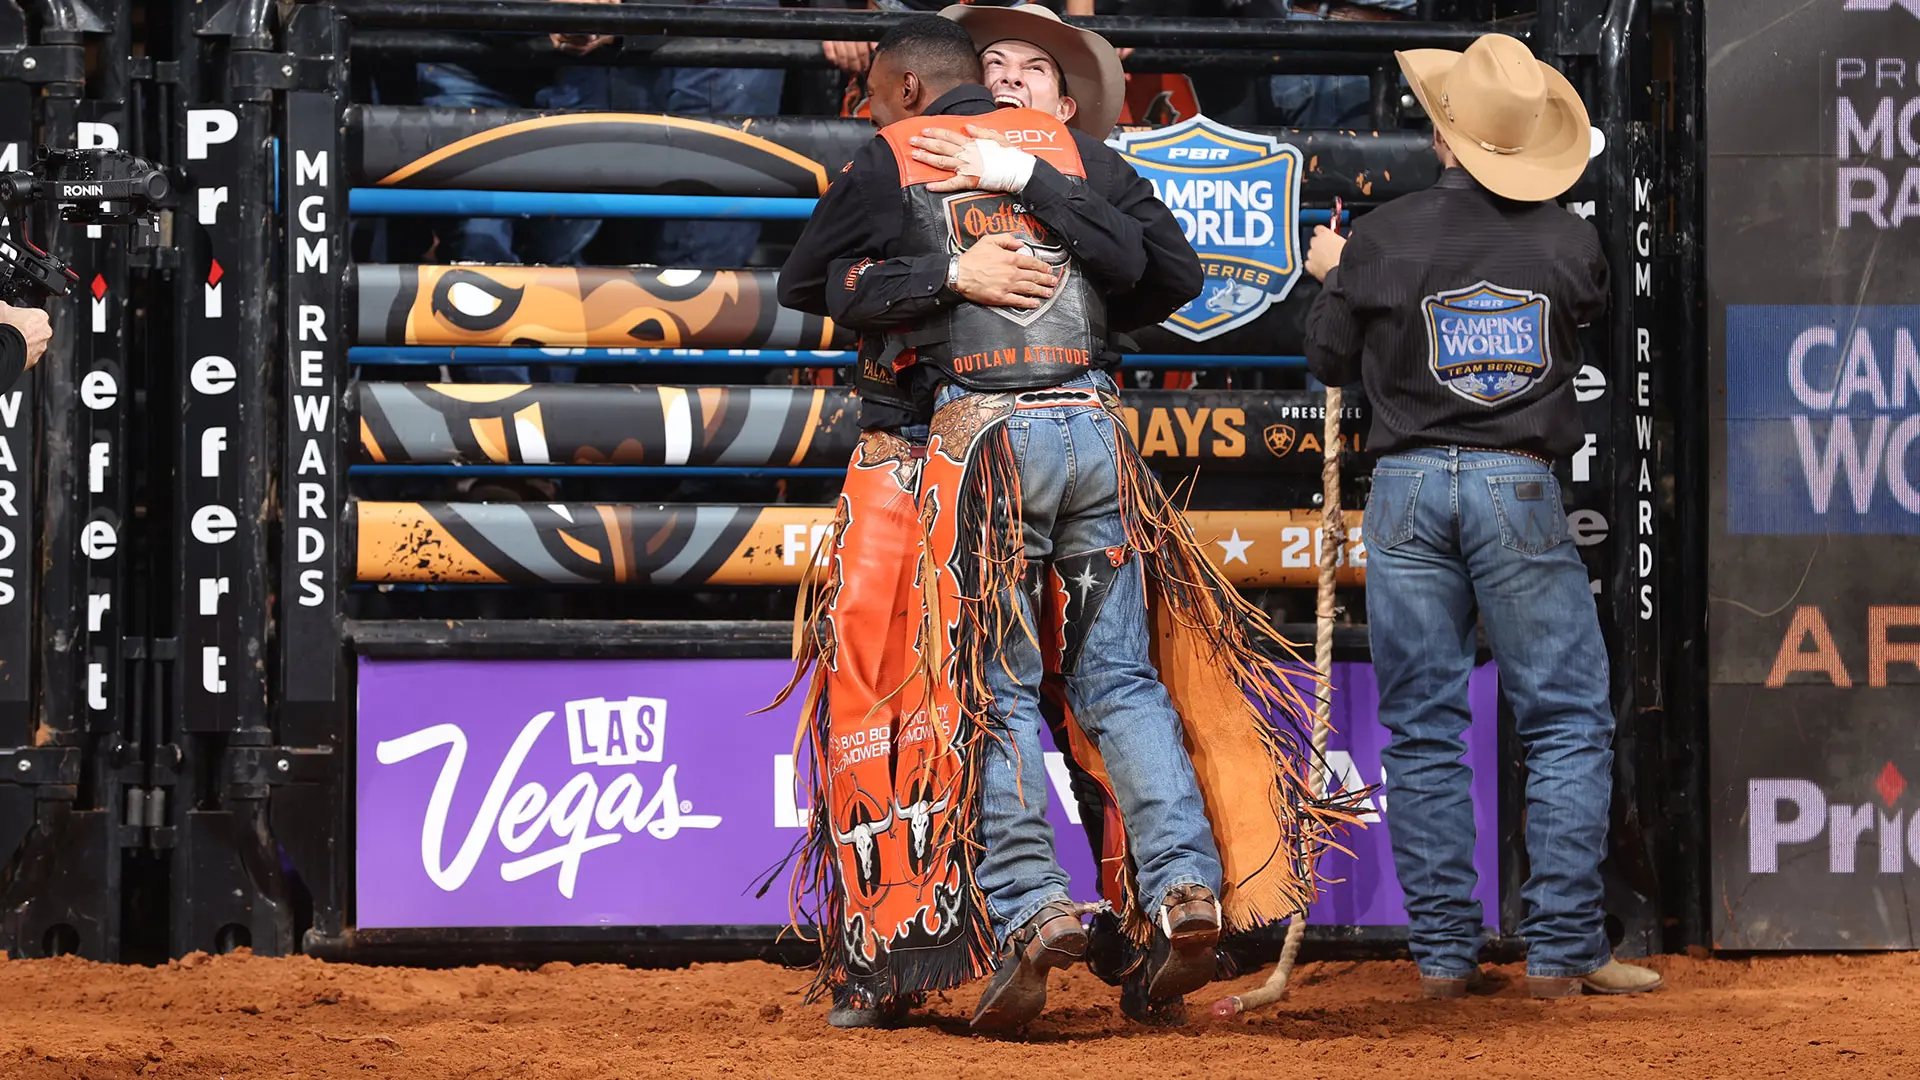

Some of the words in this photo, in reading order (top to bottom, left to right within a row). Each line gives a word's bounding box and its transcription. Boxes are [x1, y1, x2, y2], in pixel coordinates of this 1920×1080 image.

[1005, 129, 1057, 143] BOY
[1168, 147, 1230, 160] PBR
[64, 185, 103, 196] RONIN
[296, 150, 328, 274] MGM
[1635, 177, 1652, 297] MGM
[1468, 299, 1504, 307] PBR
[1440, 317, 1532, 335] CAMPING
[1442, 333, 1534, 356] WORLD
[953, 347, 1017, 374] OUTLAW
[1023, 346, 1090, 367] ATTITUDE
[1448, 364, 1483, 377] TEAM
[1487, 363, 1533, 374] SERIES
[187, 109, 238, 693] Priefert
[1281, 407, 1362, 419] PRESETED
[294, 305, 330, 606] REWARDS
[1636, 328, 1653, 620] REWARDS
[0, 389, 23, 607] WARDS
[577, 705, 656, 756] LAS
[841, 731, 865, 749] BAD
[869, 726, 890, 741] BO
[845, 741, 891, 765] MOWER
[376, 711, 723, 899] Vegas
